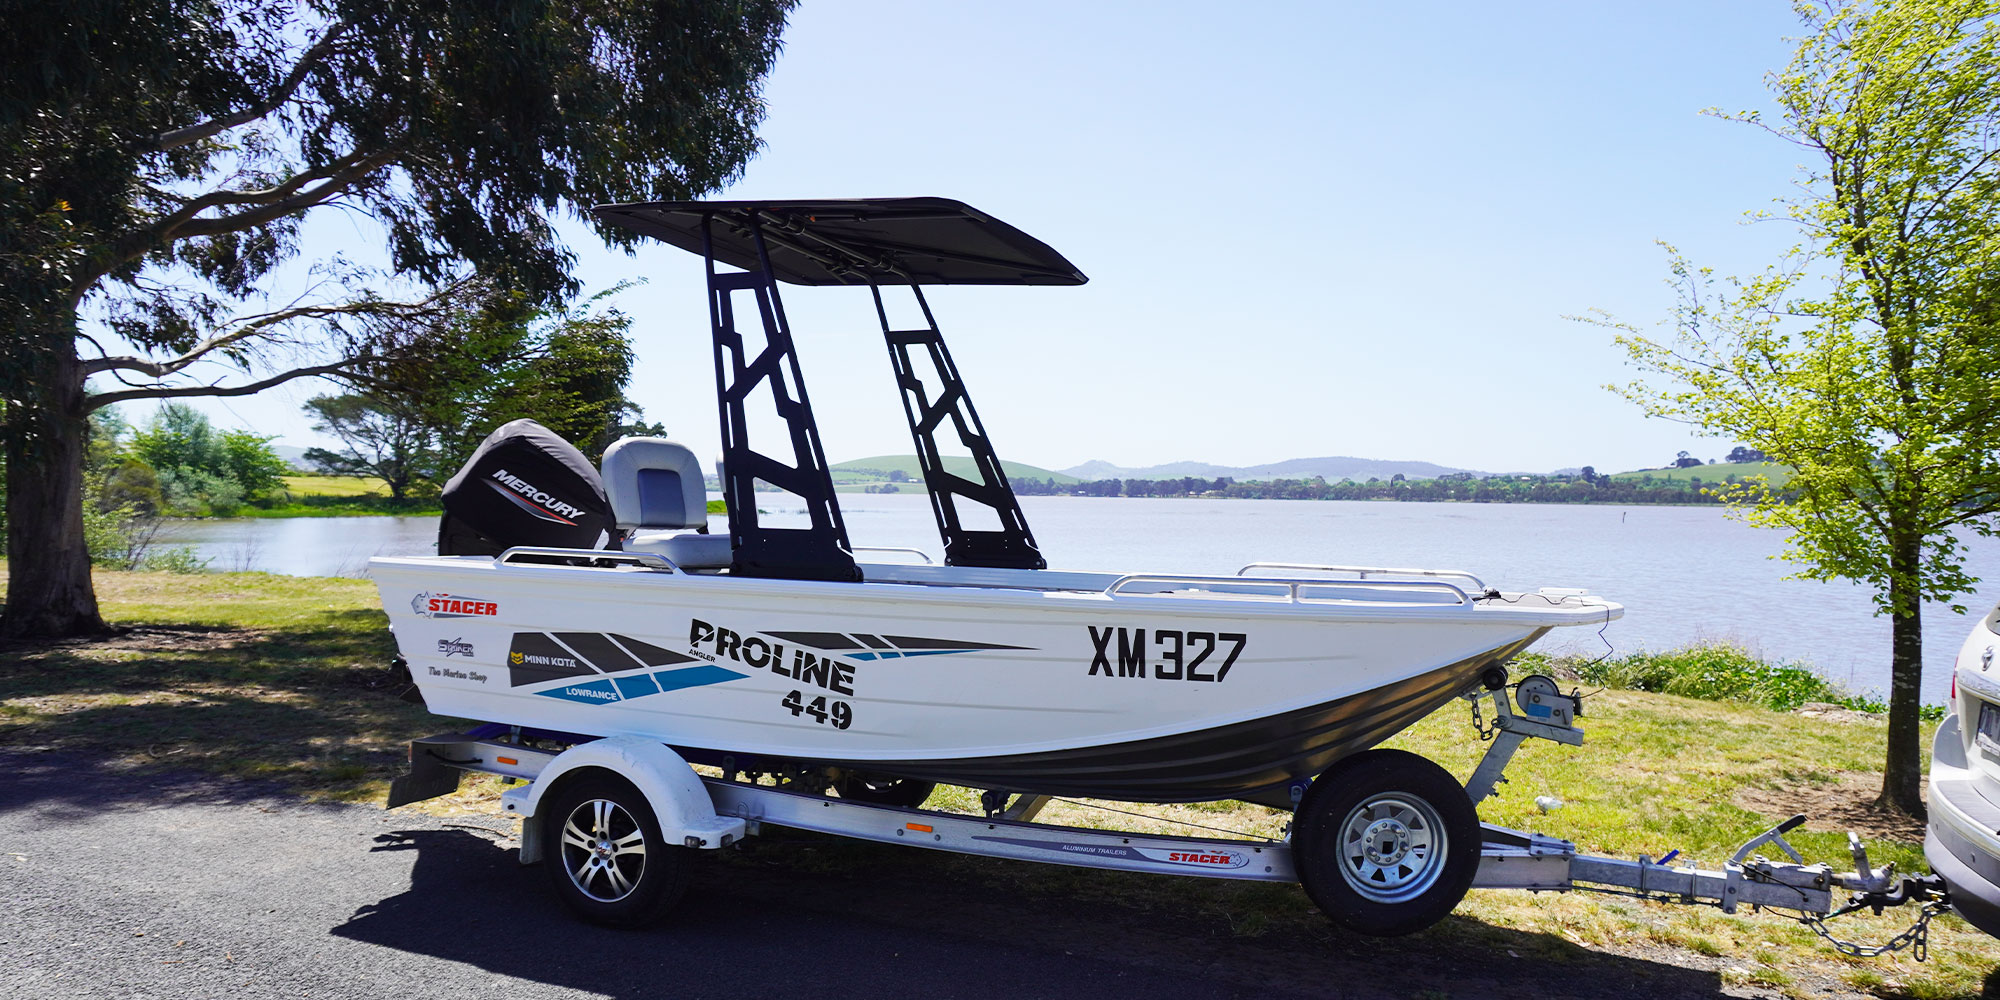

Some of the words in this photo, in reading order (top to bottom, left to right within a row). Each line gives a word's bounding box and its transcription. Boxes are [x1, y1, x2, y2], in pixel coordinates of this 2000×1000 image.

[492, 469, 586, 519] MERCURY
[428, 598, 498, 616] STACER
[524, 654, 550, 665] MINN
[551, 657, 576, 668] KOTA
[688, 648, 716, 663] ANGLER
[690, 618, 856, 697] PROLINE
[1087, 625, 1146, 679] XM
[1155, 630, 1247, 683] 327
[428, 666, 441, 676] The
[443, 668, 467, 680] Marine
[469, 671, 487, 684] Shop
[565, 687, 618, 701] LOWRANCE
[781, 689, 853, 731] 449
[1097, 848, 1127, 856] TRAILERS
[1169, 852, 1231, 865] STACER
